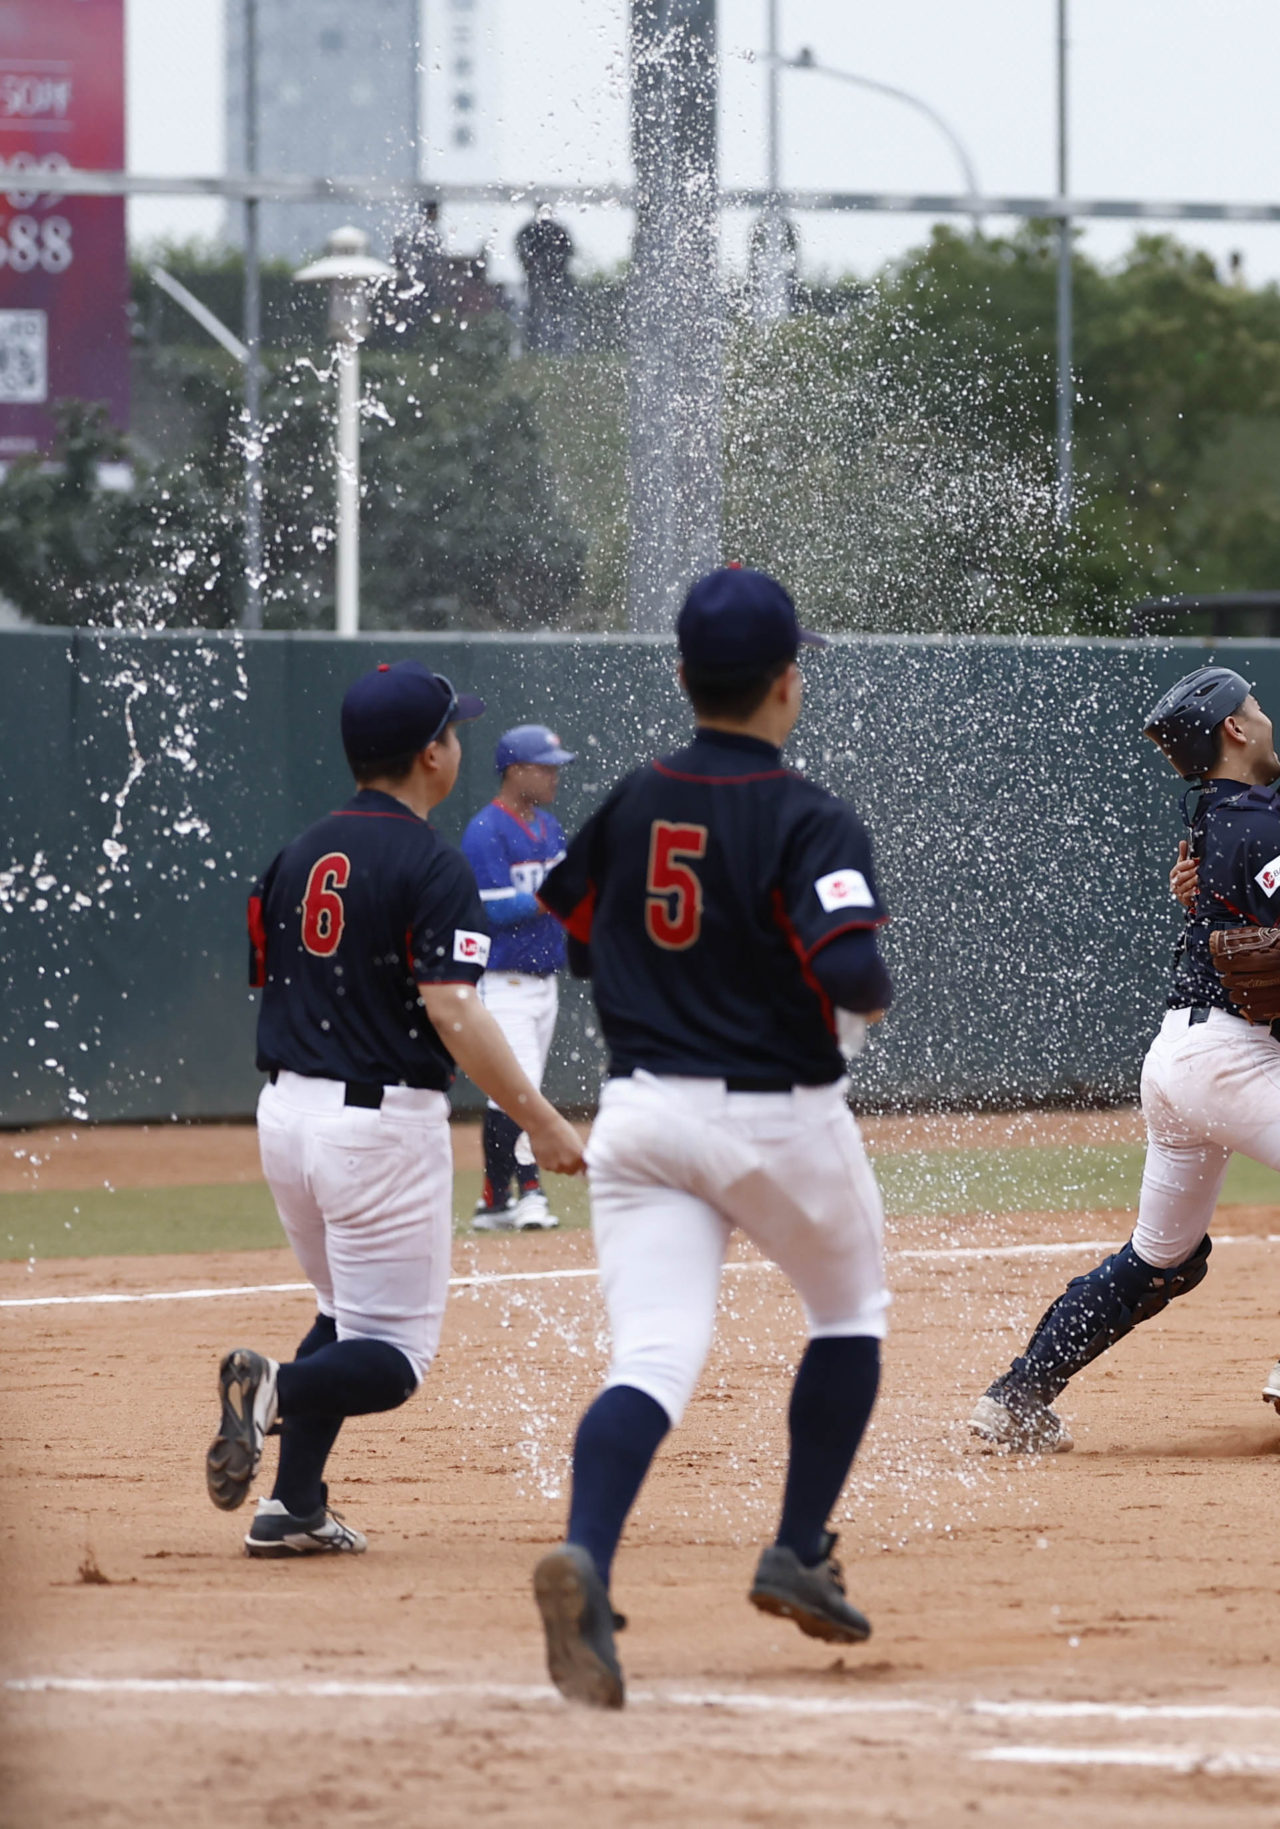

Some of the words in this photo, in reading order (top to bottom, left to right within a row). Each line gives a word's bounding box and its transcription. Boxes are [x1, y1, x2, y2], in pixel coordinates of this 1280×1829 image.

[0, 214, 73, 273] 88
[301, 851, 351, 958] 6
[645, 819, 709, 951] 5
